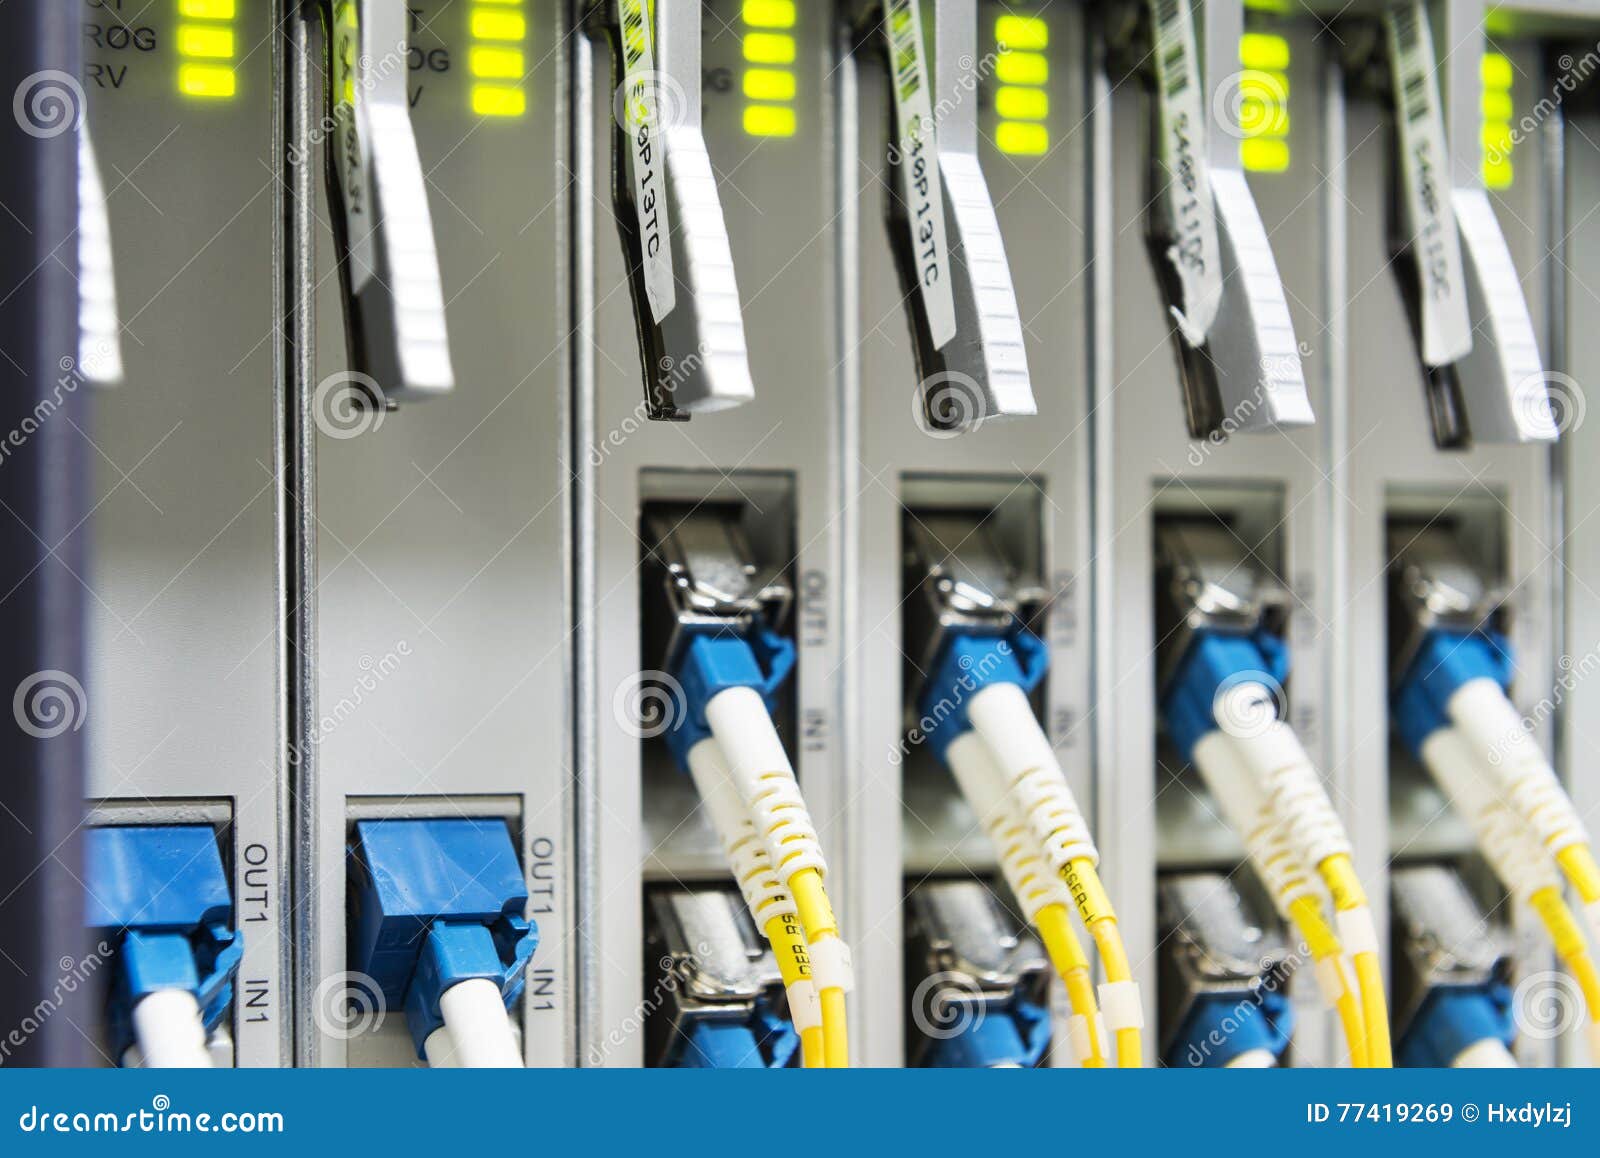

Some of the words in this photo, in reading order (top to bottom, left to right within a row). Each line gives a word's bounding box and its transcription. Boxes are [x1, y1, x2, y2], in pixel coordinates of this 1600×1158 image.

[244, 843, 269, 923] OUT1
[531, 837, 554, 914] OUT1
[245, 979, 269, 1023] IN1
[533, 969, 555, 1012] IN1
